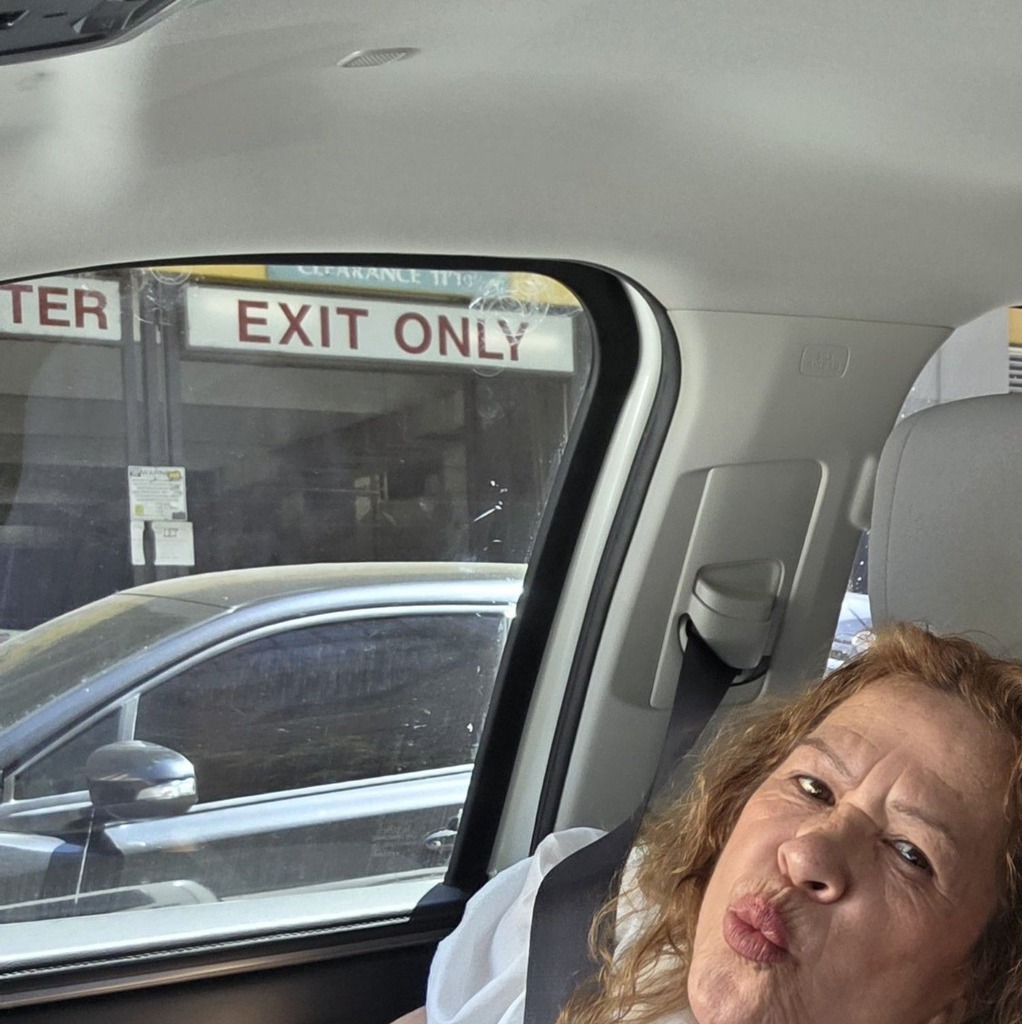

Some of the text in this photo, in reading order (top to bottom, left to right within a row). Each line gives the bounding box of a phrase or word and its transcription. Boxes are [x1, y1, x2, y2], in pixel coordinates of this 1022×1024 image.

[297, 265, 421, 283] CLEARANCE
[0, 284, 108, 330] TER
[237, 299, 529, 362] EXIT ONLY
